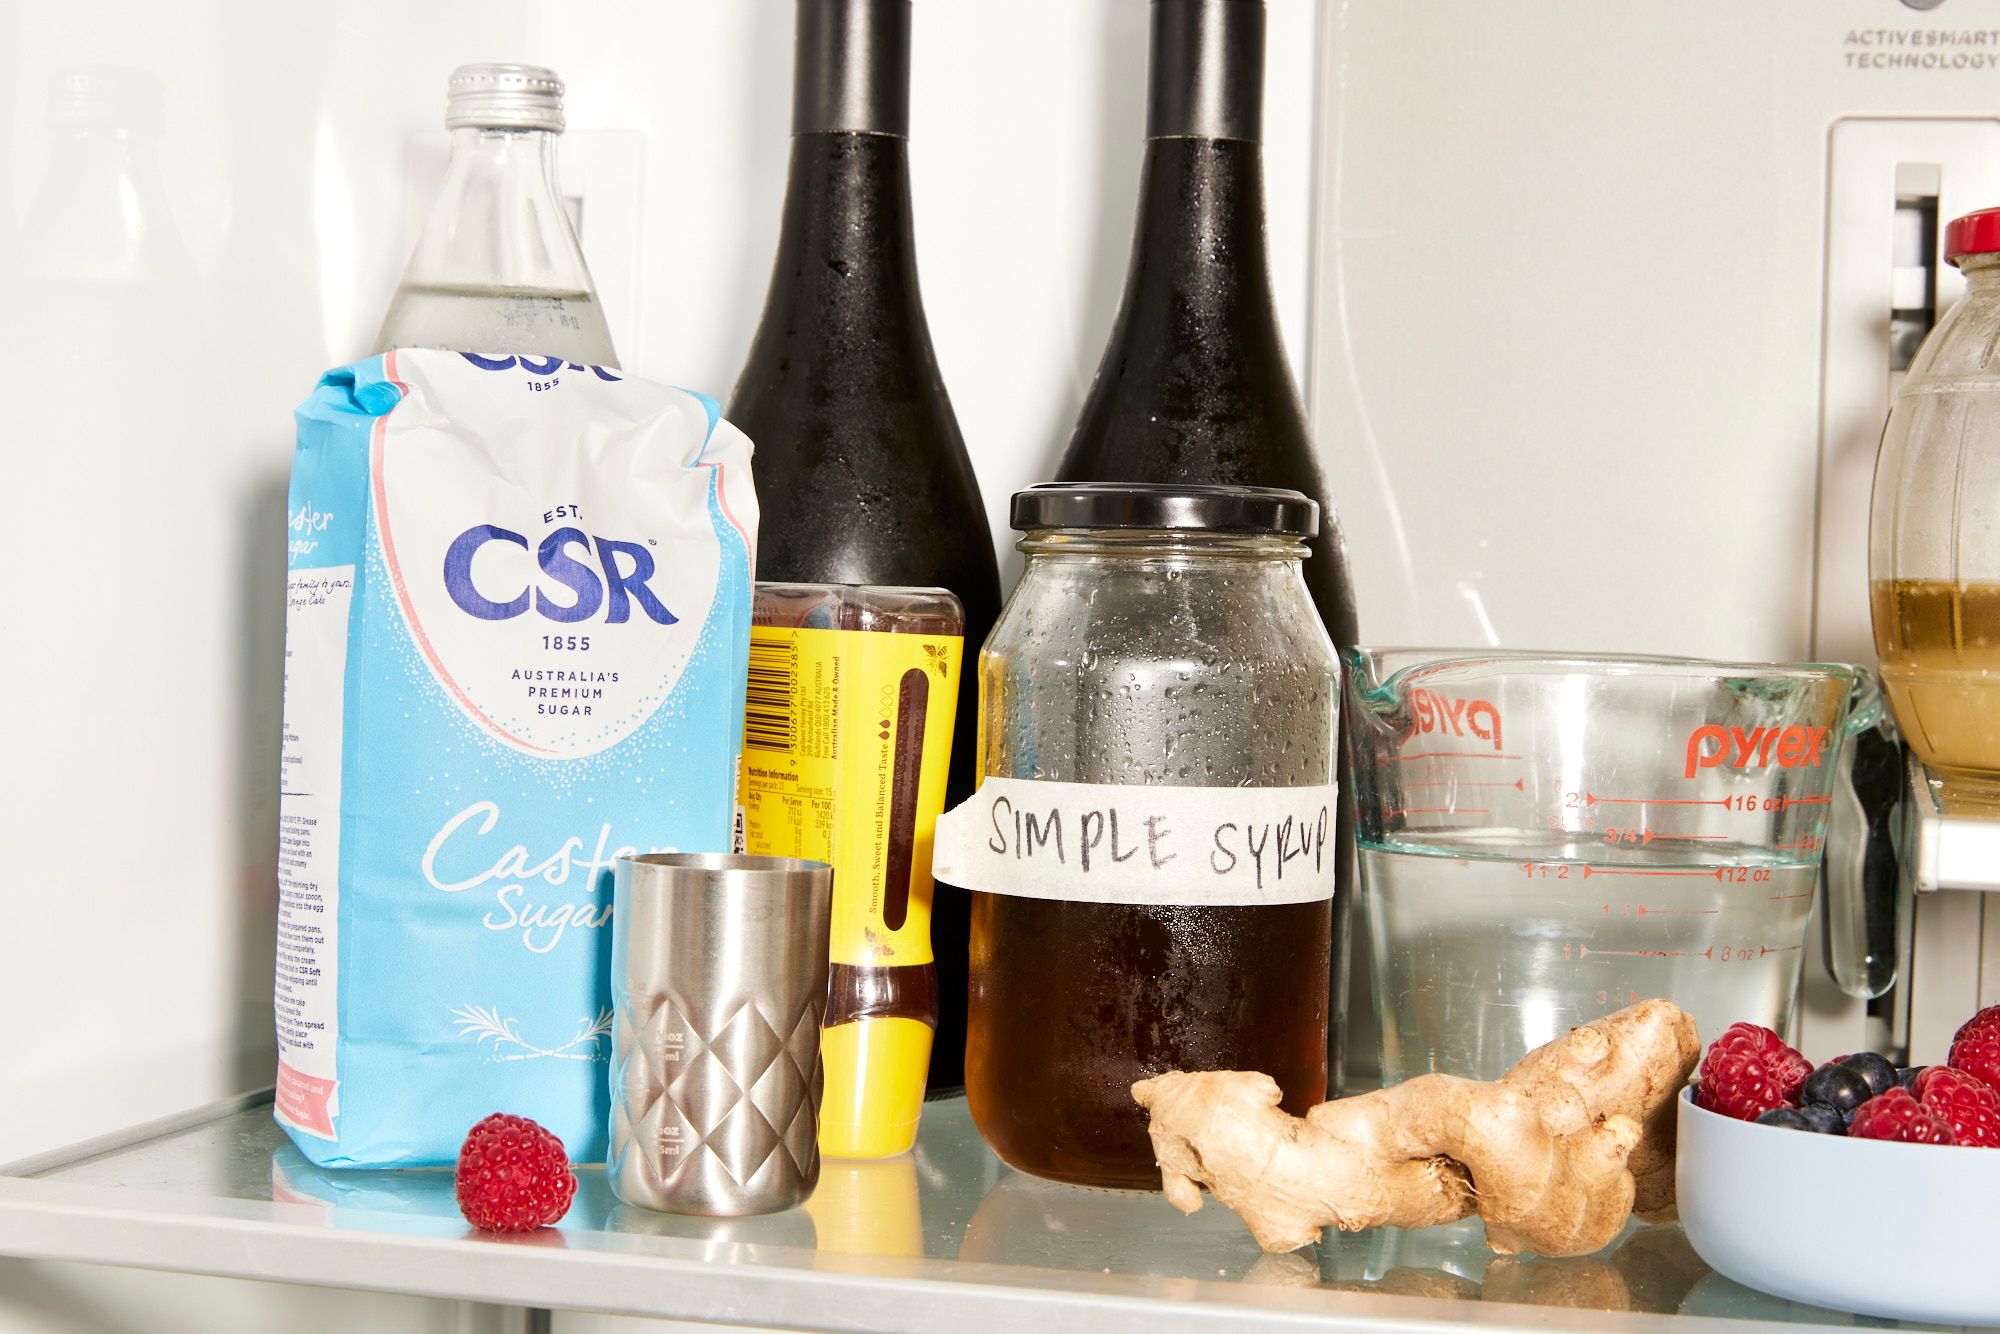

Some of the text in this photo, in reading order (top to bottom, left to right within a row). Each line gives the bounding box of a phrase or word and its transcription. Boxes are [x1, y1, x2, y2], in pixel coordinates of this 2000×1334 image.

[1845, 52, 1998, 69] TECHNOLOGY
[527, 377, 560, 392] 1855
[543, 504, 584, 523] EST.
[443, 524, 679, 625] CSR
[543, 635, 590, 651] 1855
[511, 669, 619, 683] AUSTRALIA'S
[815, 661, 823, 696] AUSTRALIA
[832, 656, 840, 685] Owned
[528, 686, 602, 699] PREMIUM
[538, 704, 592, 716] SUGAR
[807, 700, 814, 709] Rd
[814, 714, 822, 727] QLD
[814, 728, 822, 759] Richlands
[822, 732, 830, 745] Call
[831, 719, 839, 760] Australian
[822, 745, 830, 759] Free
[1684, 724, 1826, 779] pyrex
[811, 799, 820, 809] Per
[1735, 795, 1757, 812] 16
[1763, 800, 1783, 812] oz
[869, 743, 889, 914] Smooth, Sweet and Balanced Taste
[988, 796, 1328, 890] SIMPLE SYRUP
[1726, 867, 1748, 883] 12
[1752, 869, 1771, 882] oz
[313, 904, 324, 913] egg
[304, 1020, 325, 1030] spread
